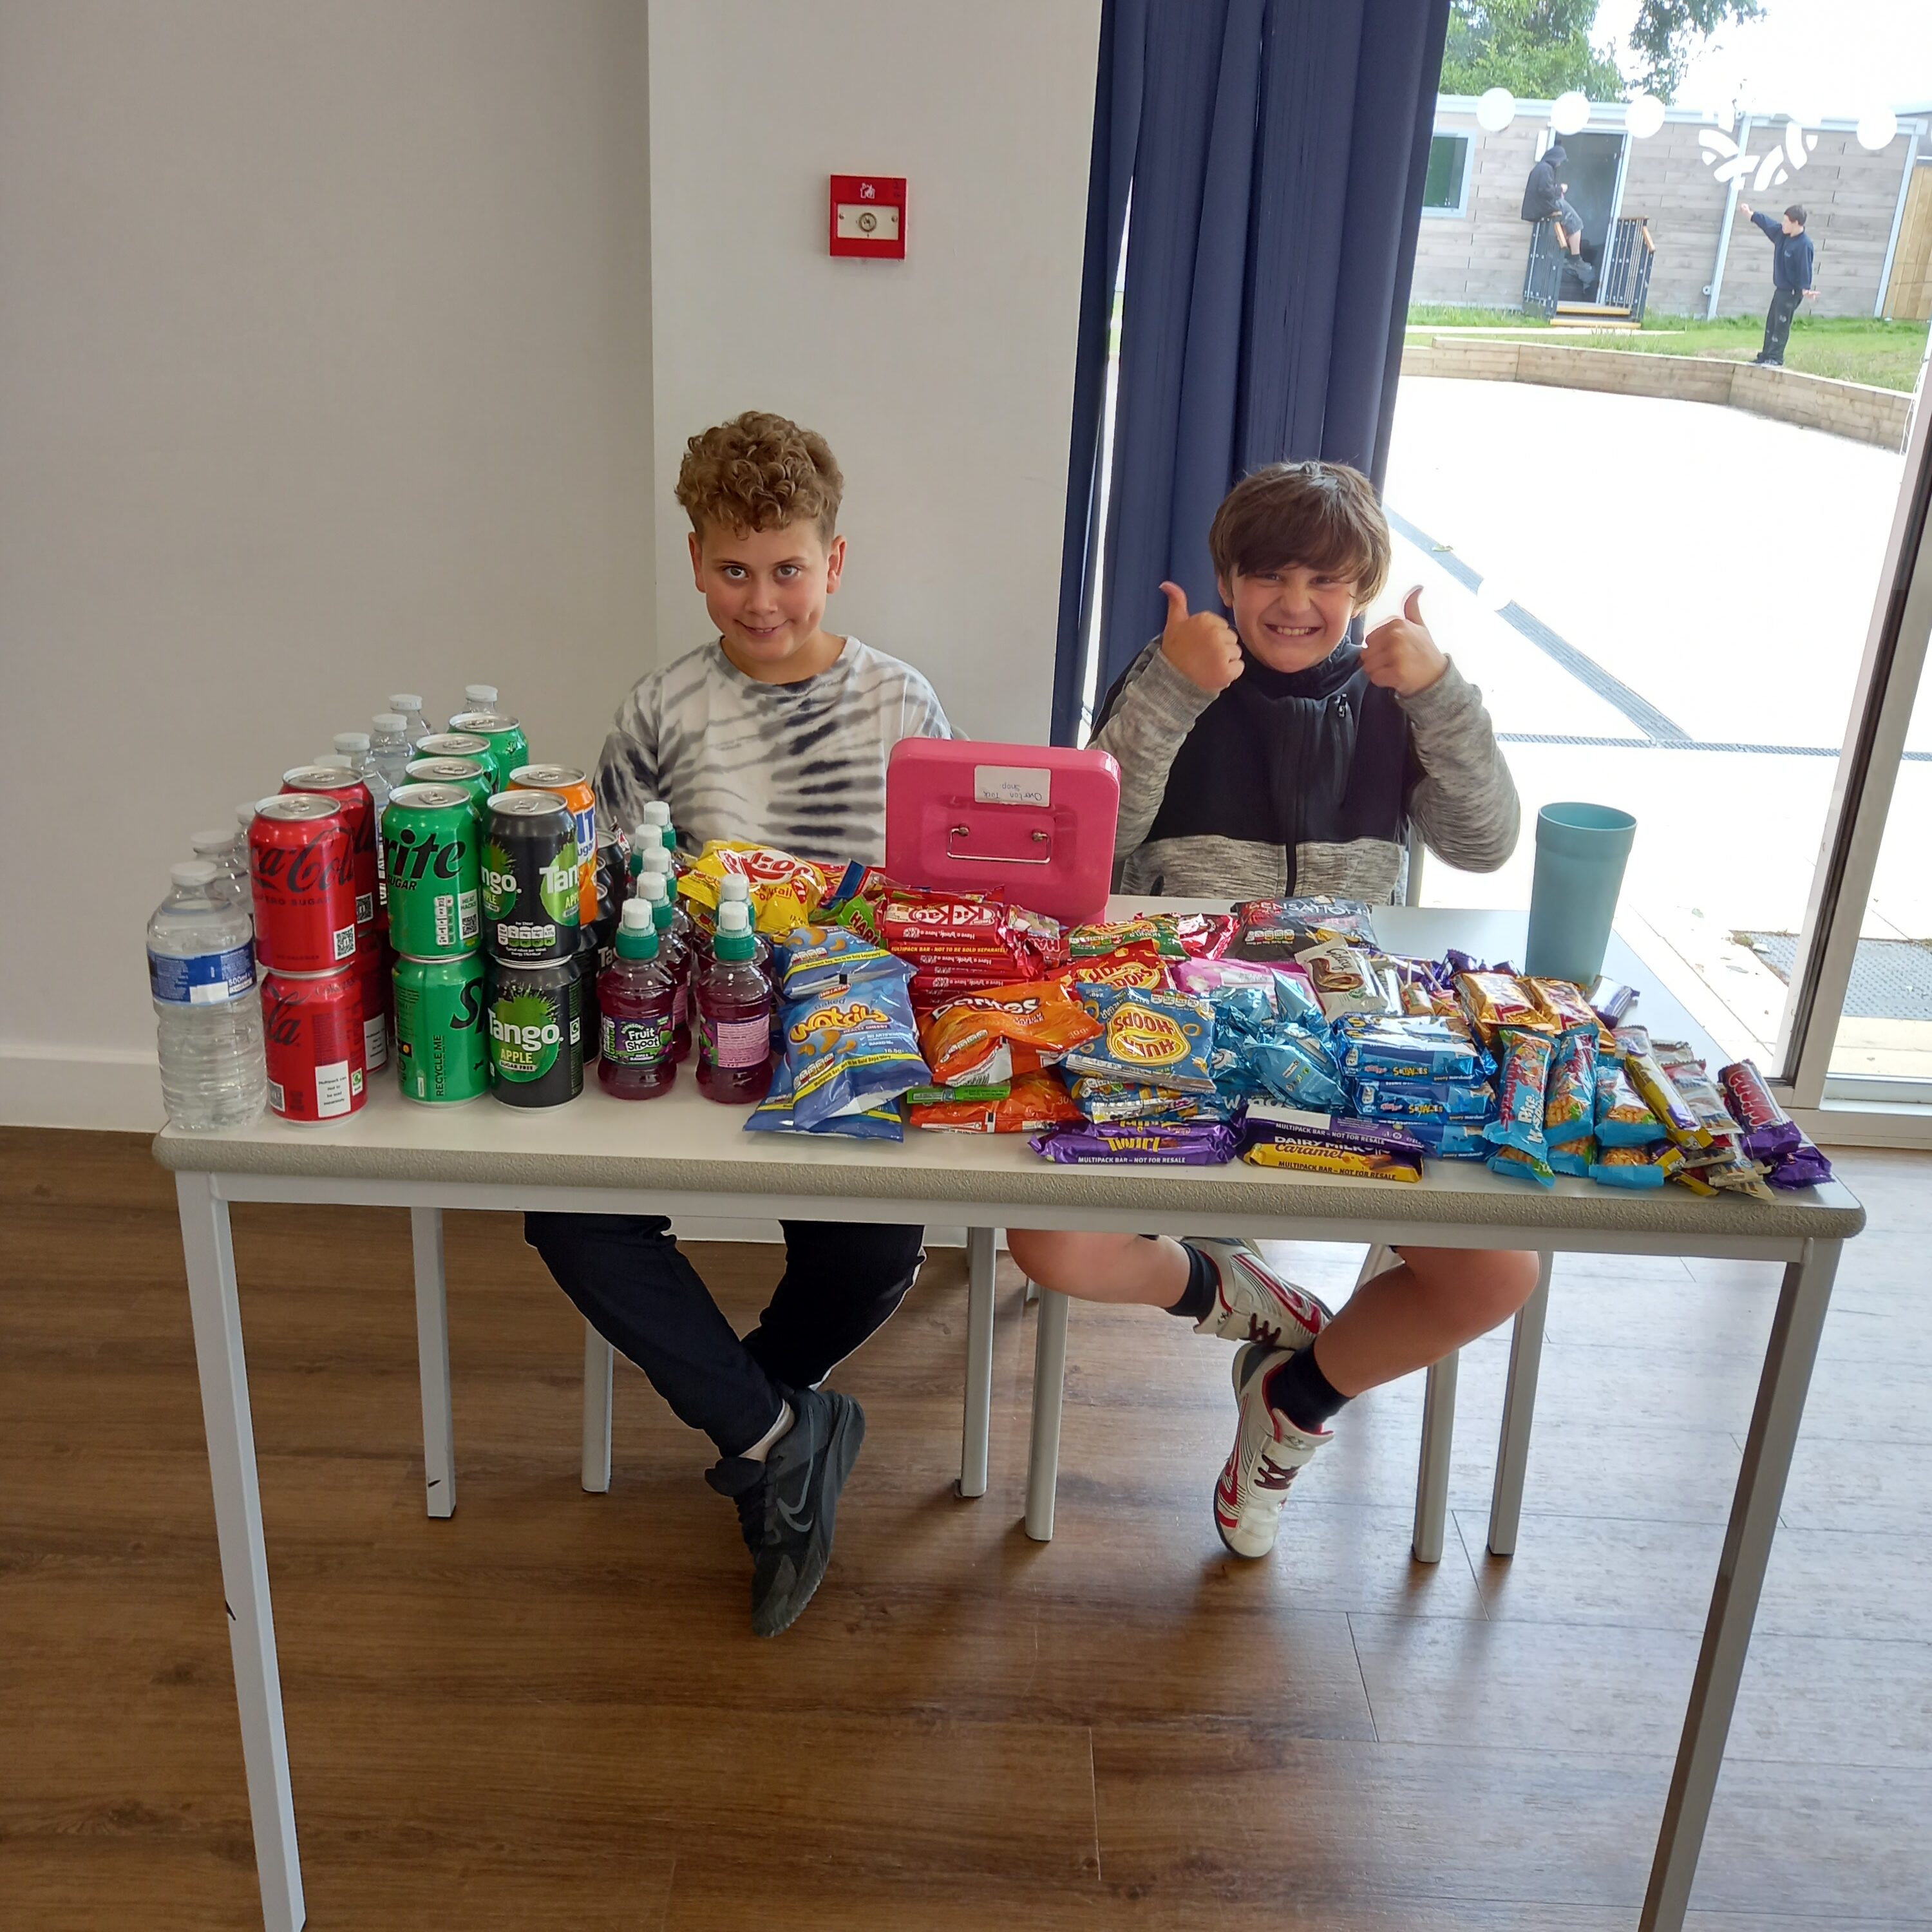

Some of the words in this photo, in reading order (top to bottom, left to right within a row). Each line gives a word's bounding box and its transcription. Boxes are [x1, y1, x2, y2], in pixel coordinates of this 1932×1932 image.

[387, 828, 467, 880] rite
[578, 843, 593, 857] ugar
[482, 866, 522, 895] ngo.
[539, 866, 578, 894] Tan
[565, 893, 579, 909] APP
[849, 909, 880, 946] HARI
[1113, 968, 1153, 987] OOPS
[1113, 1012, 1175, 1036] HOOPS
[433, 1034, 442, 1051] ME
[628, 1028, 655, 1041] Fruit
[626, 1037, 659, 1052] Shoot
[500, 1048, 533, 1064] APPLE
[433, 1052, 445, 1097] RECYCLE
[1275, 1122, 1311, 1134] MULTIPACK
[1312, 1127, 1326, 1136] BAR
[1331, 1131, 1345, 1139] NOT
[1346, 1133, 1359, 1142] FOR
[1360, 1135, 1385, 1146] RESALE
[1274, 1135, 1323, 1147] DAIRY
[1325, 1142, 1365, 1153] MILK
[1275, 1143, 1344, 1159] Caramel
[1278, 1160, 1317, 1171] MULTIPACK
[1318, 1164, 1332, 1173] BAR
[1340, 1168, 1354, 1177] NOT
[1354, 1170, 1370, 1179] FOR
[1370, 1171, 1396, 1180] RESALE
